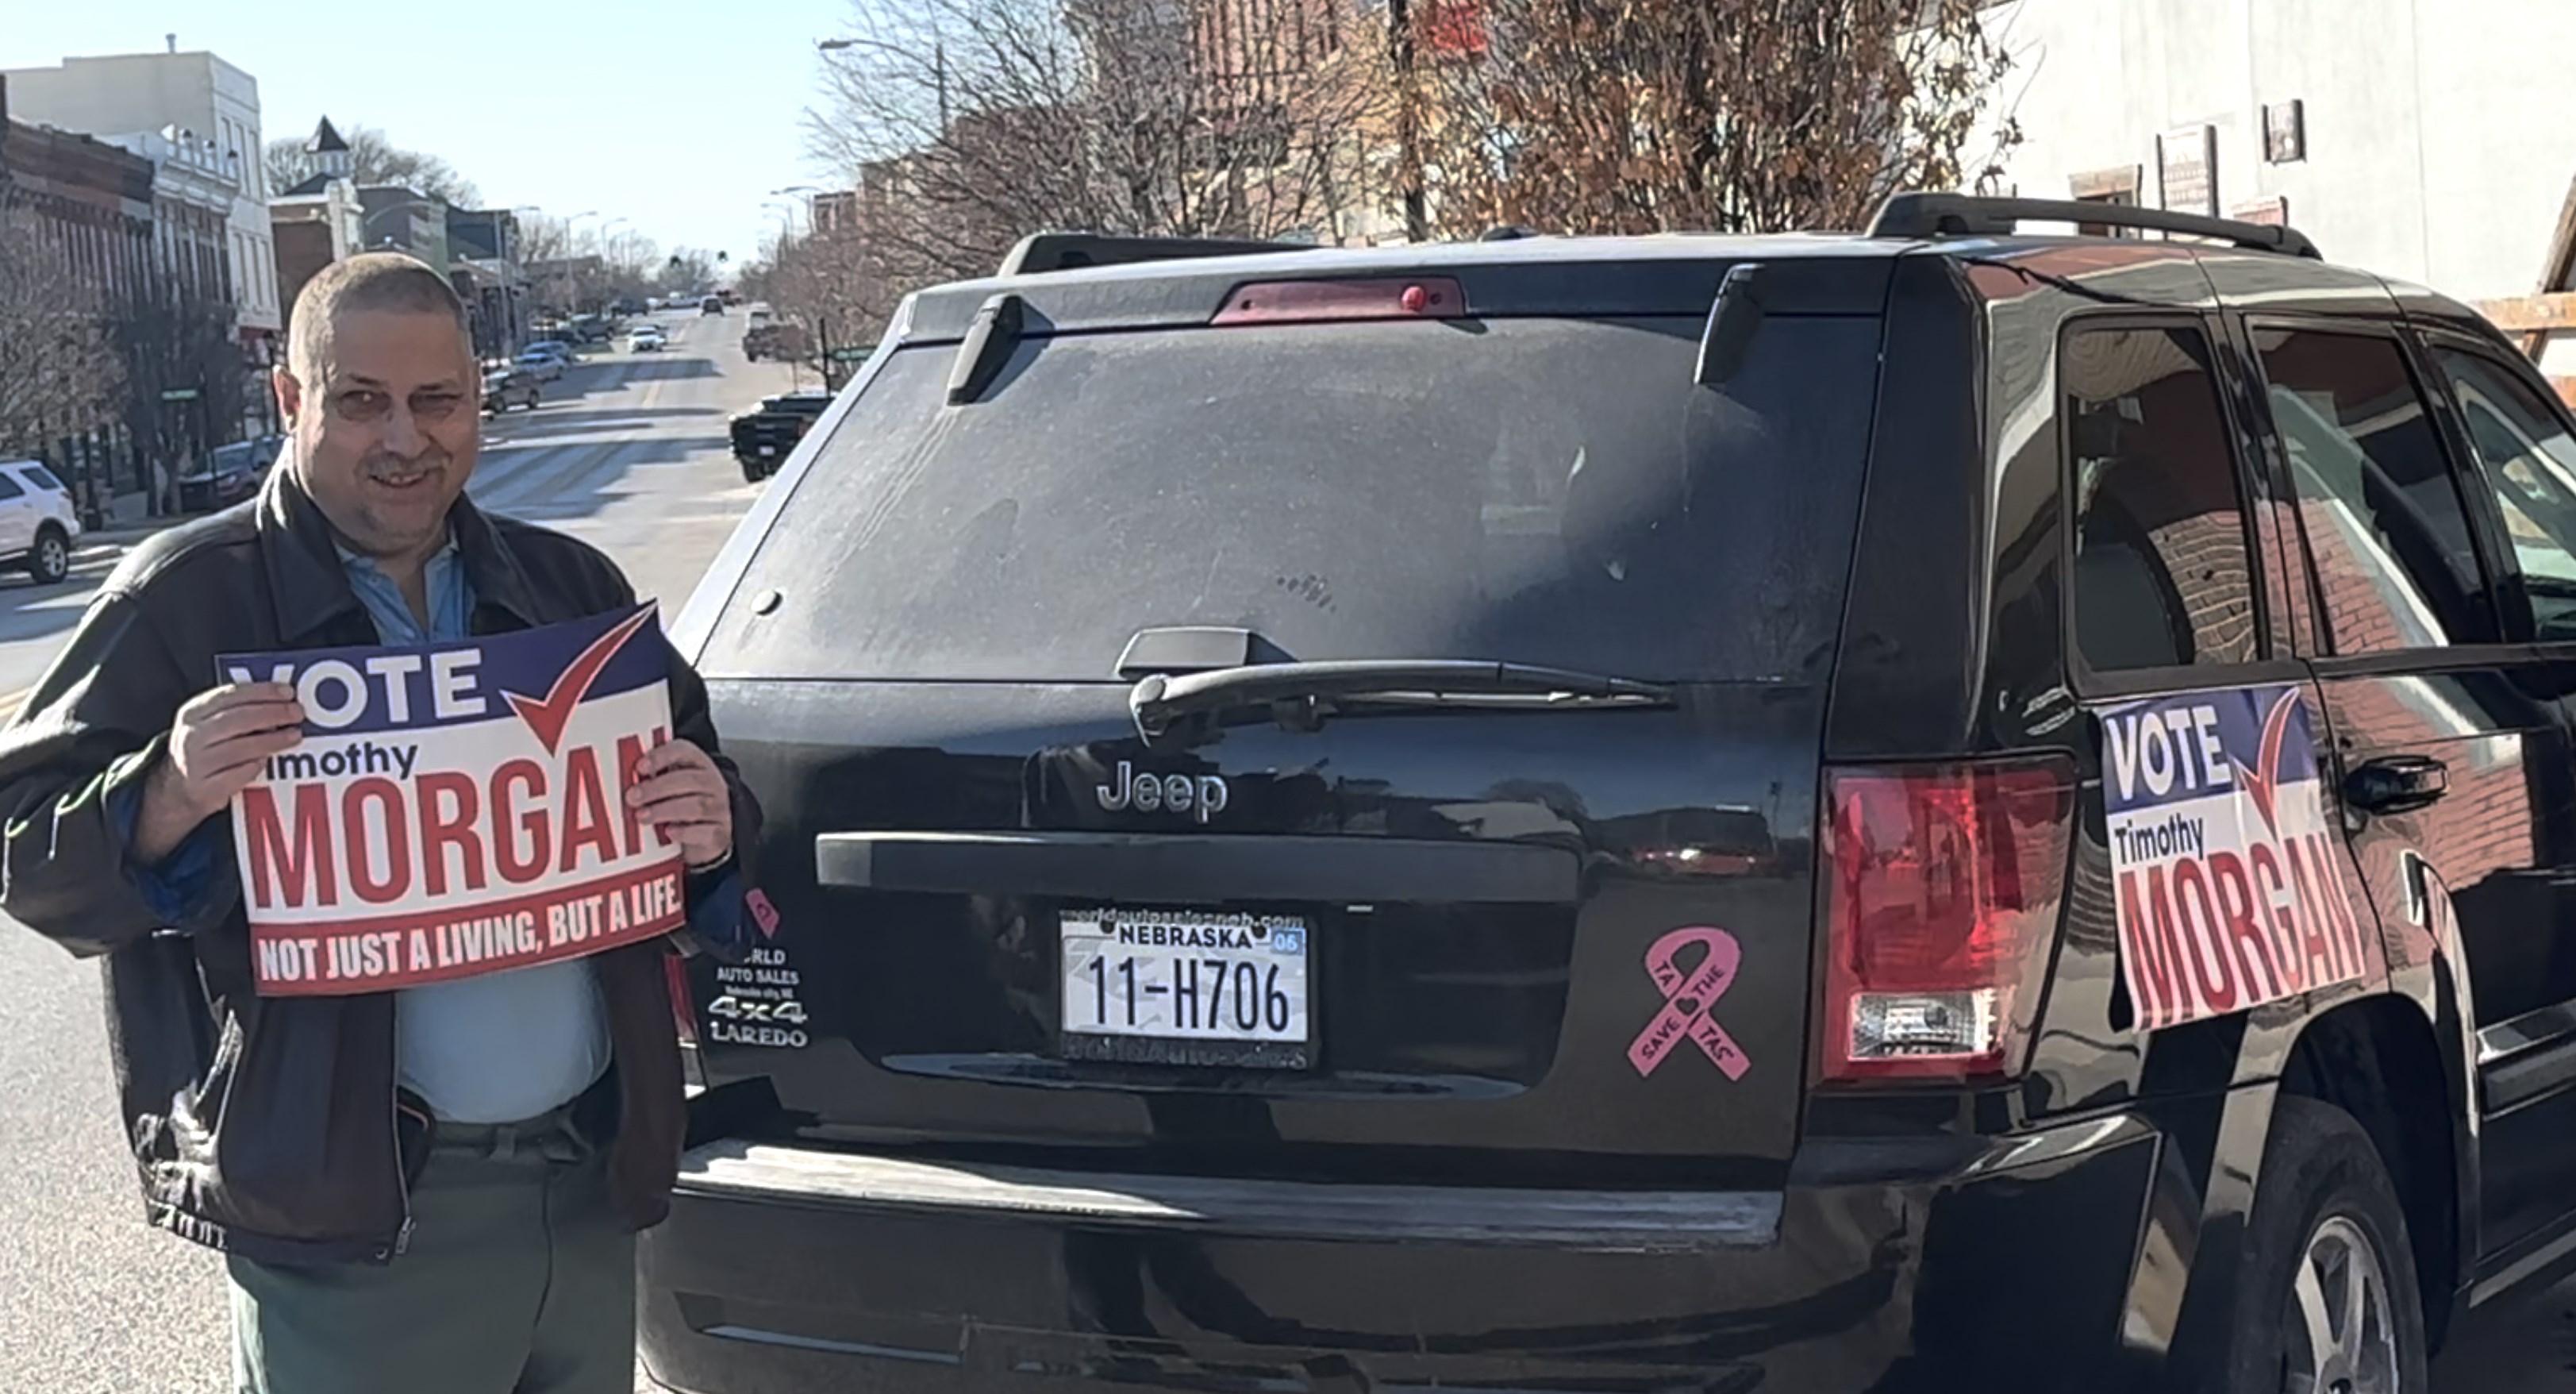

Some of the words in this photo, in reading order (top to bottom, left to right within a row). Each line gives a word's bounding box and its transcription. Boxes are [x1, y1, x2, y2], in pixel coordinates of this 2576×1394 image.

[266, 741, 418, 780] imothy
[2106, 705, 2233, 802] VOTE
[1096, 760, 1228, 824] Jeep
[2115, 812, 2204, 865] Timothy
[258, 938, 319, 982] NOT
[325, 932, 404, 978] JUST
[409, 933, 437, 971] A
[438, 911, 545, 967] LIVING,
[548, 898, 605, 947] BUT
[609, 894, 628, 930] A
[630, 880, 683, 926] LIFE.
[744, 948, 786, 965] RLD
[1119, 925, 1253, 949] NEBRASKA
[2118, 831, 2363, 1029] MORGAN
[717, 966, 753, 982] AUTO
[755, 969, 800, 985] SALES
[1089, 955, 1289, 1033] 11-H706
[1653, 960, 1675, 988] TA
[709, 1021, 808, 1048] LAREDO
[1641, 1016, 1681, 1061] SAVE
[1691, 964, 1725, 996] THE
